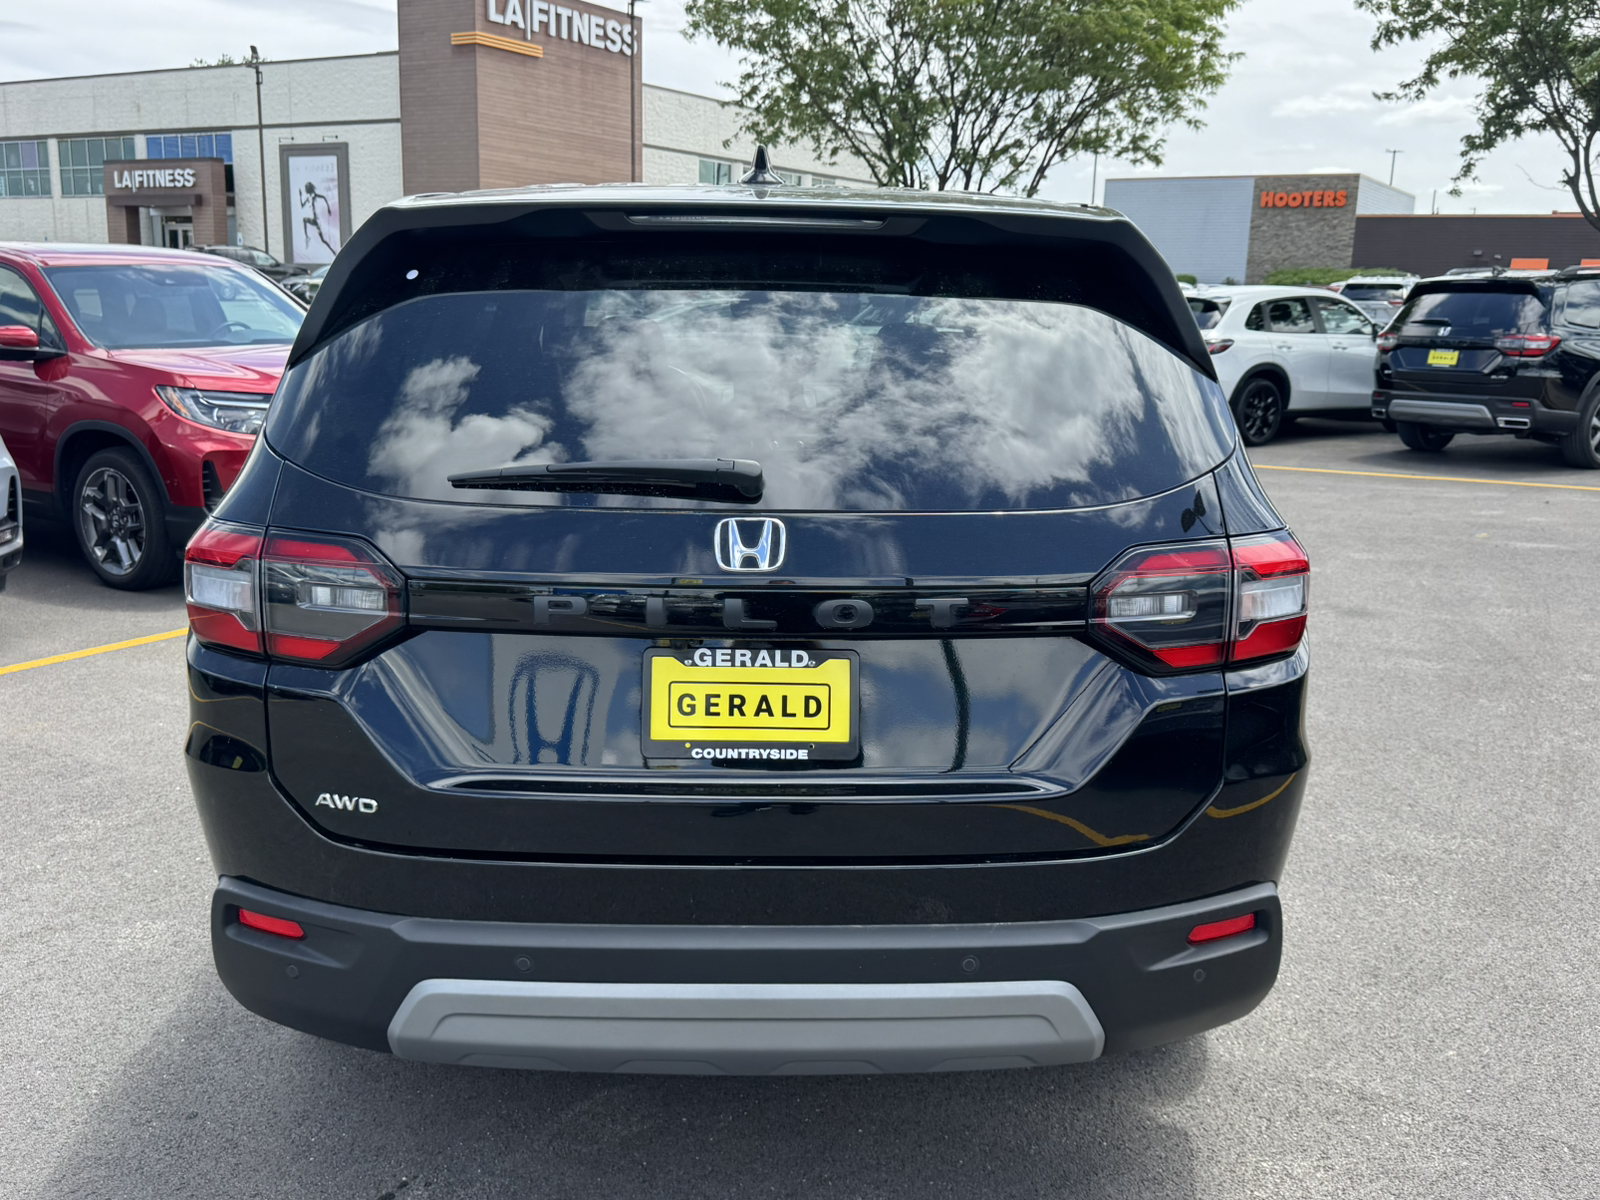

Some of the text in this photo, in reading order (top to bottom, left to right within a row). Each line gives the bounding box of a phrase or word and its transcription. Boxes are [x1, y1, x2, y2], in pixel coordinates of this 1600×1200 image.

[1260, 189, 1348, 209] HOOTERS
[533, 595, 969, 630] PILOT
[693, 648, 809, 668] GERALD
[676, 692, 823, 719] GERALD
[690, 748, 809, 760] COUNTRYSIDE
[314, 792, 379, 814] AWD
